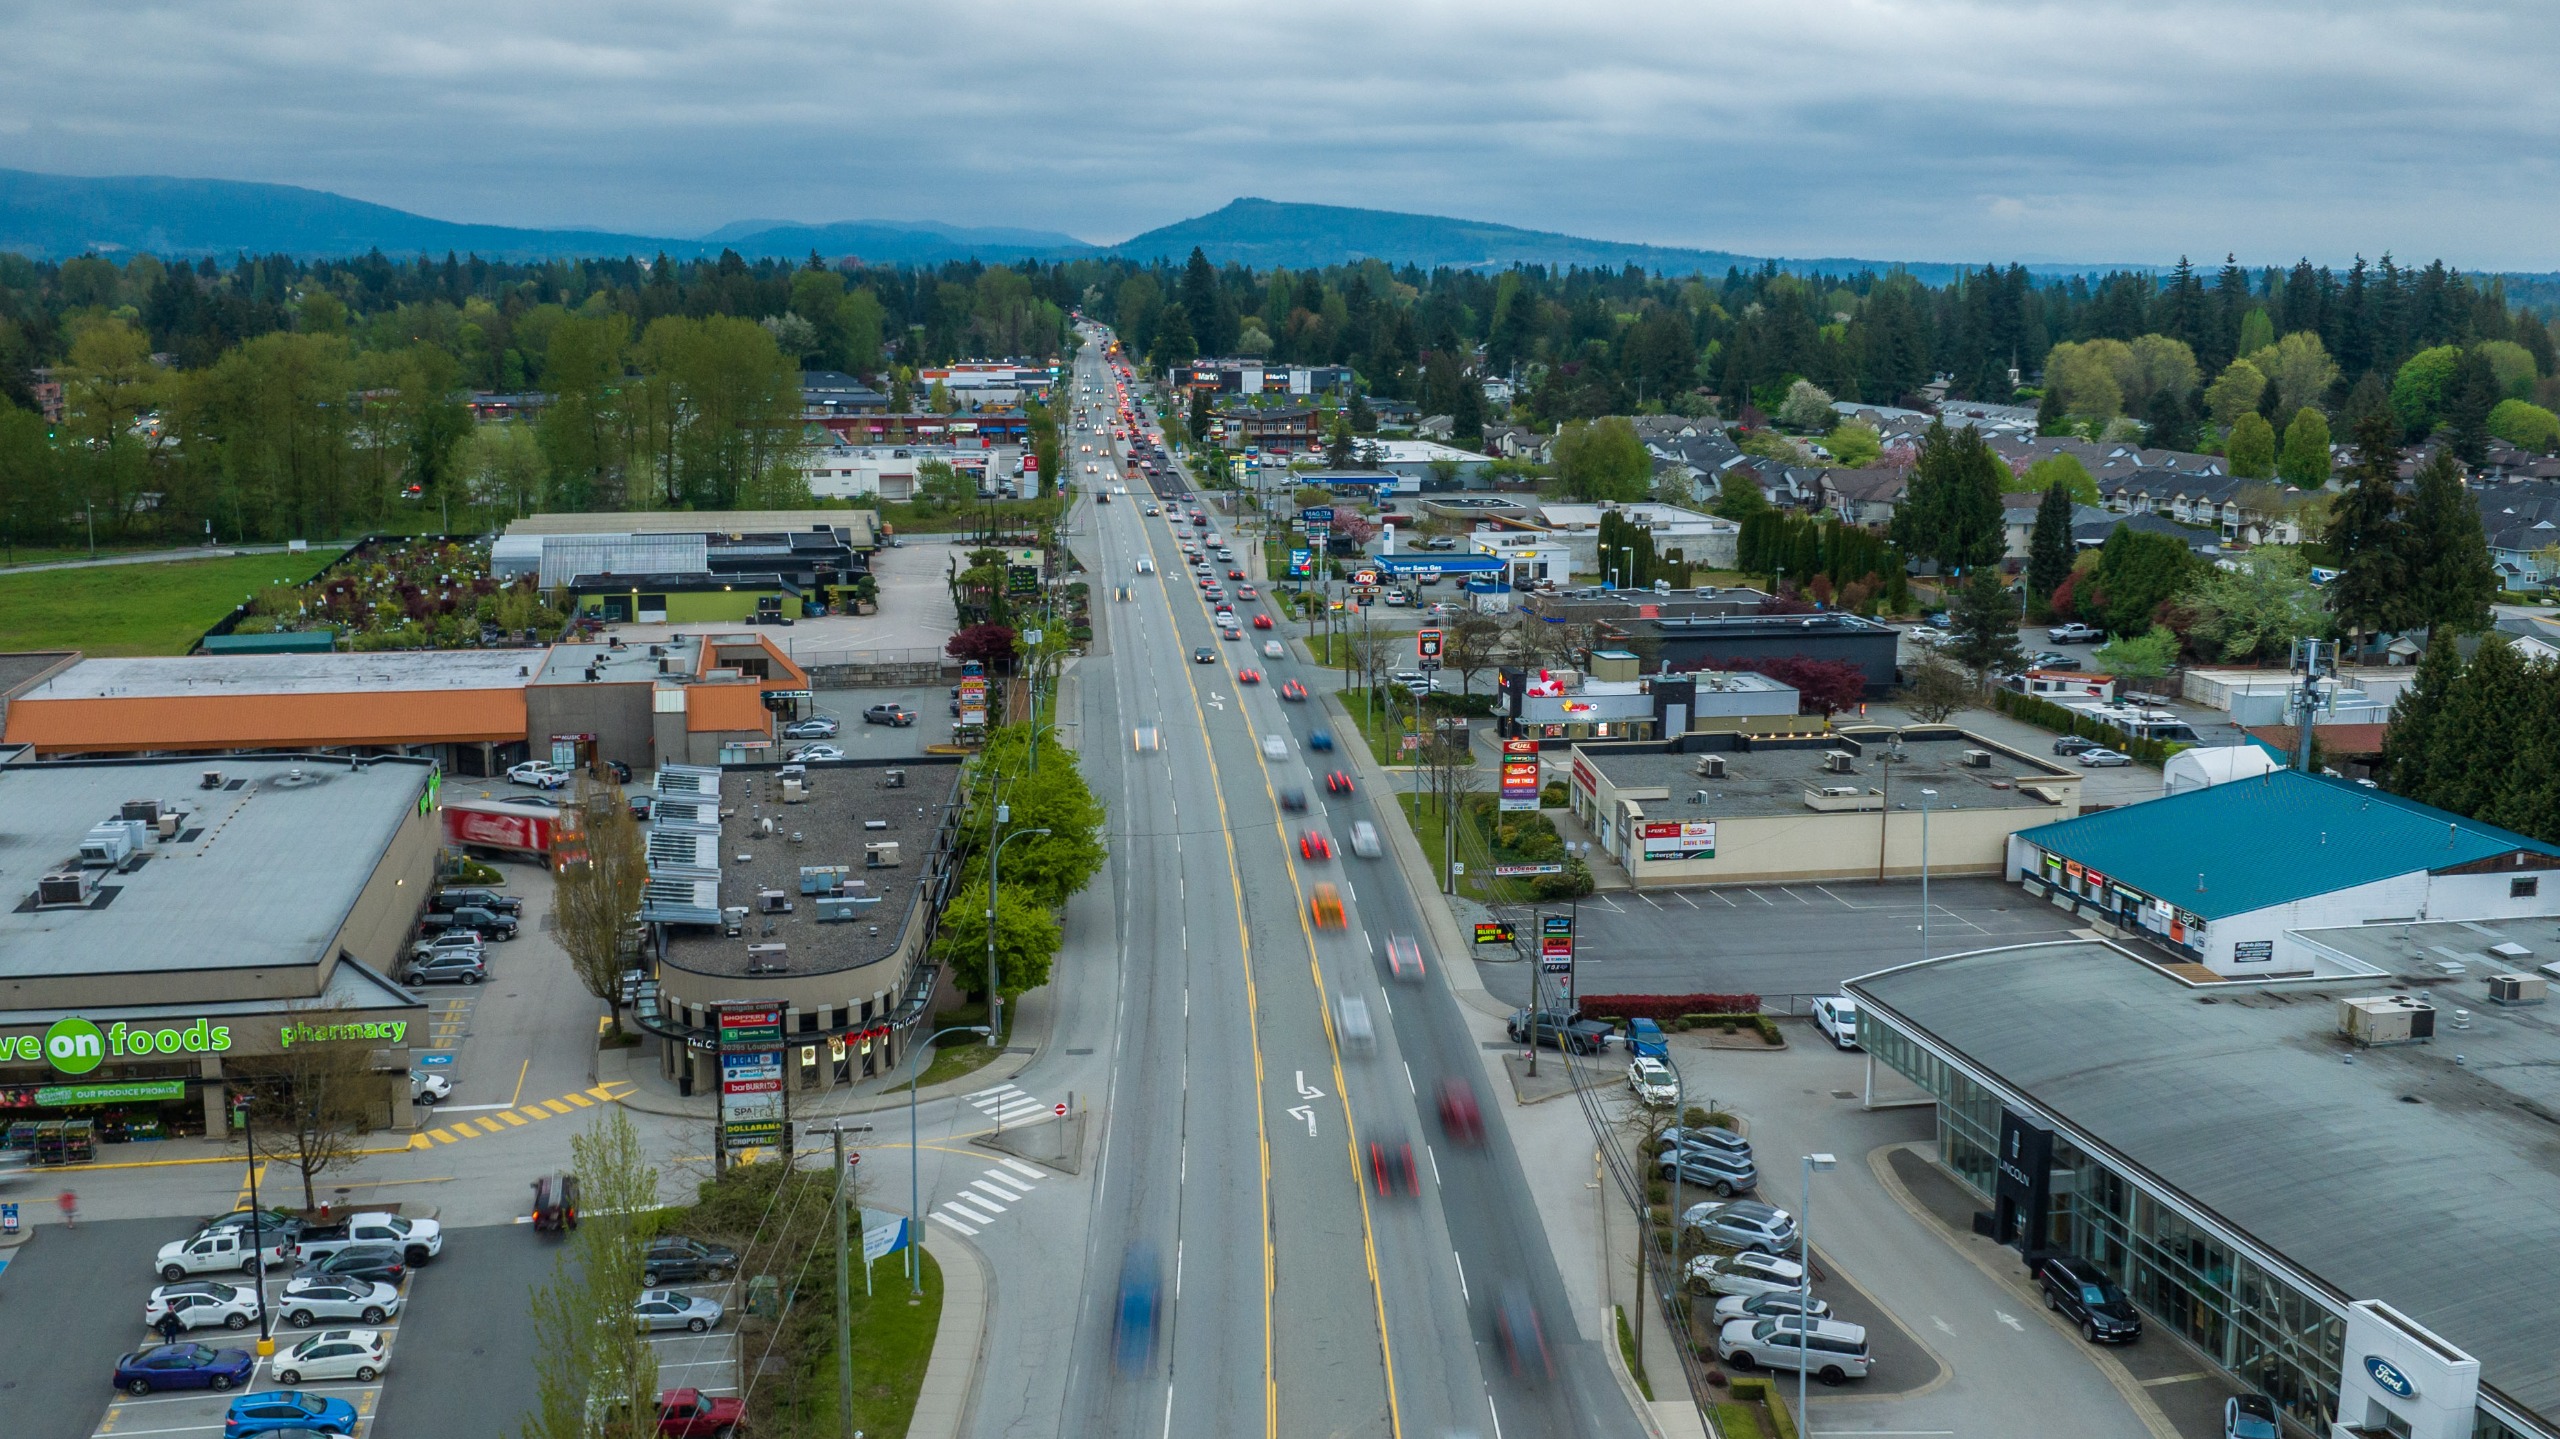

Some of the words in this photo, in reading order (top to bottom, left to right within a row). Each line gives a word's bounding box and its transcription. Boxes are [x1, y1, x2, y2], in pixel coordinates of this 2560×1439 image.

[1198, 372, 1218, 381] Mark's
[1359, 574, 1373, 583] DQ
[723, 1012, 766, 1021] SHOPPERS
[49, 1034, 101, 1059] on
[108, 1018, 232, 1056] foods
[281, 1021, 407, 1048] pharmacy
[748, 1042, 785, 1050] Lougheed
[732, 1056, 759, 1065] BCAA
[76, 1090, 96, 1099] OUR
[97, 1088, 139, 1097] PRODUCE
[140, 1086, 179, 1095] PROMISE
[734, 1107, 752, 1116] SPA
[727, 1122, 781, 1133] DOLLARAMA
[1999, 1158, 2030, 1187] LINCOLN
[2375, 1363, 2403, 1391] Ford
